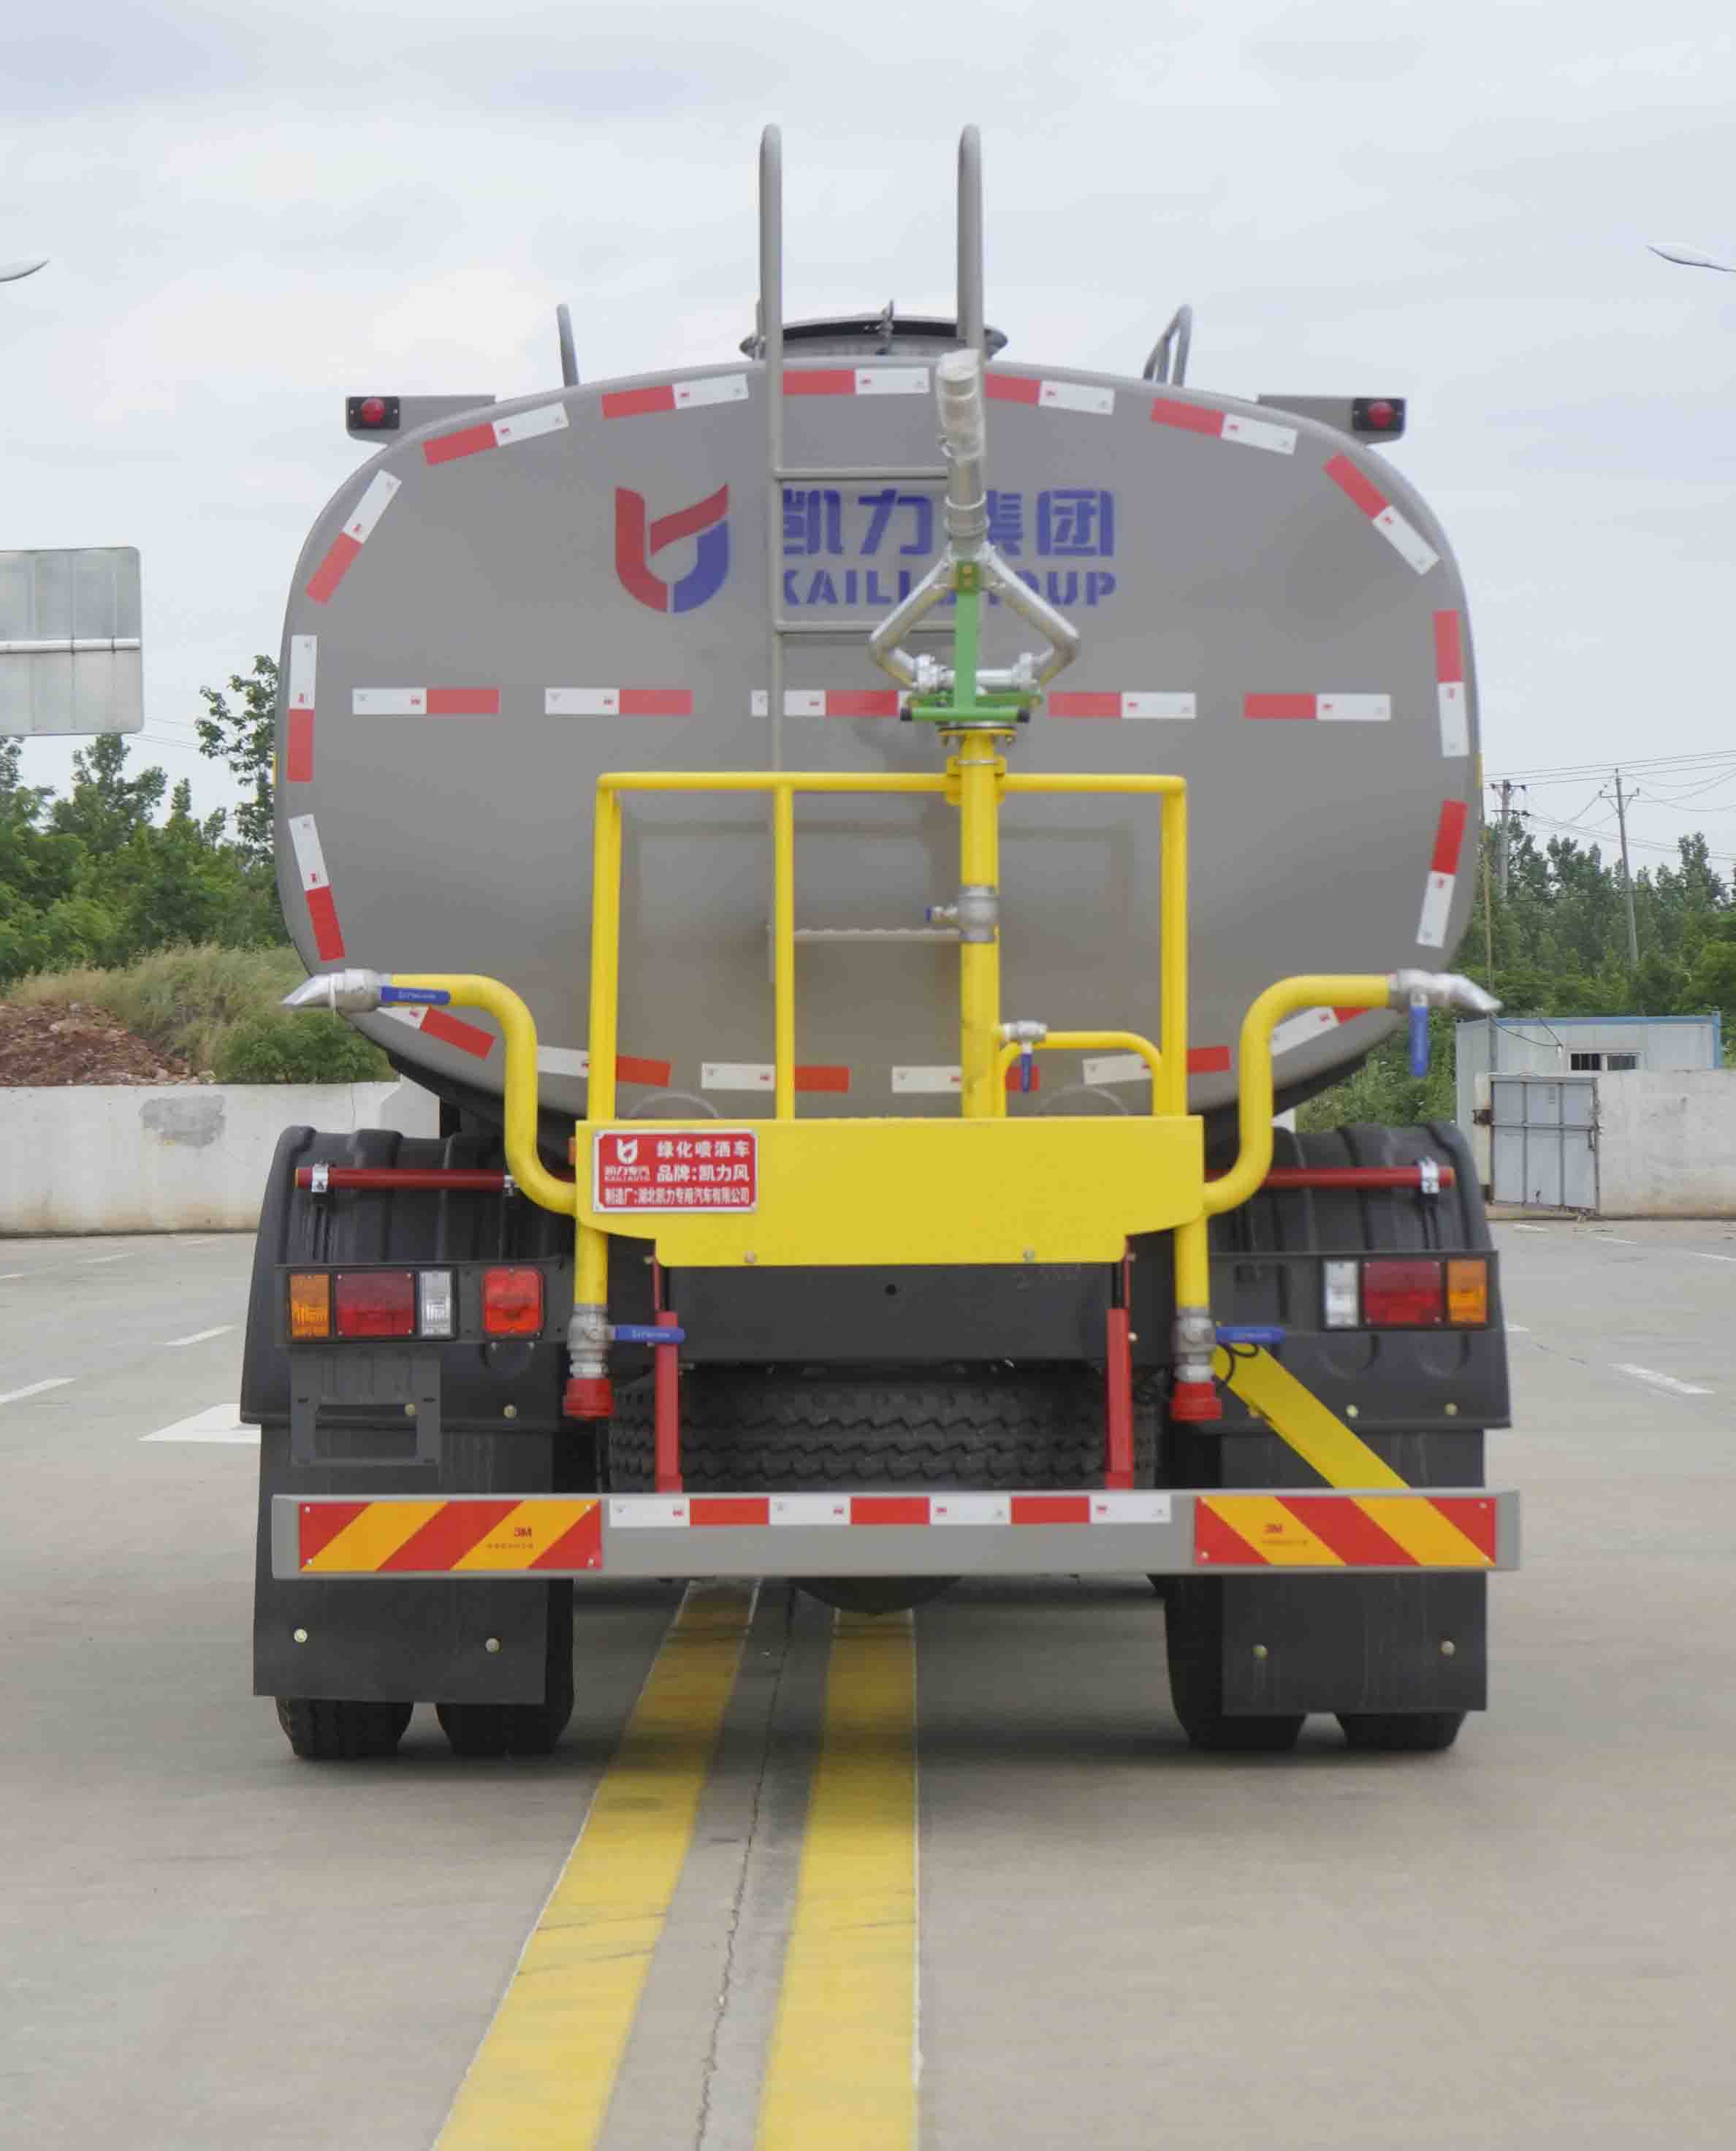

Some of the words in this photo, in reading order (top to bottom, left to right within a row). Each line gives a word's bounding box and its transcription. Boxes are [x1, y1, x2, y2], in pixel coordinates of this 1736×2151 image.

[657, 1141, 750, 1157] 绿化喷洒车
